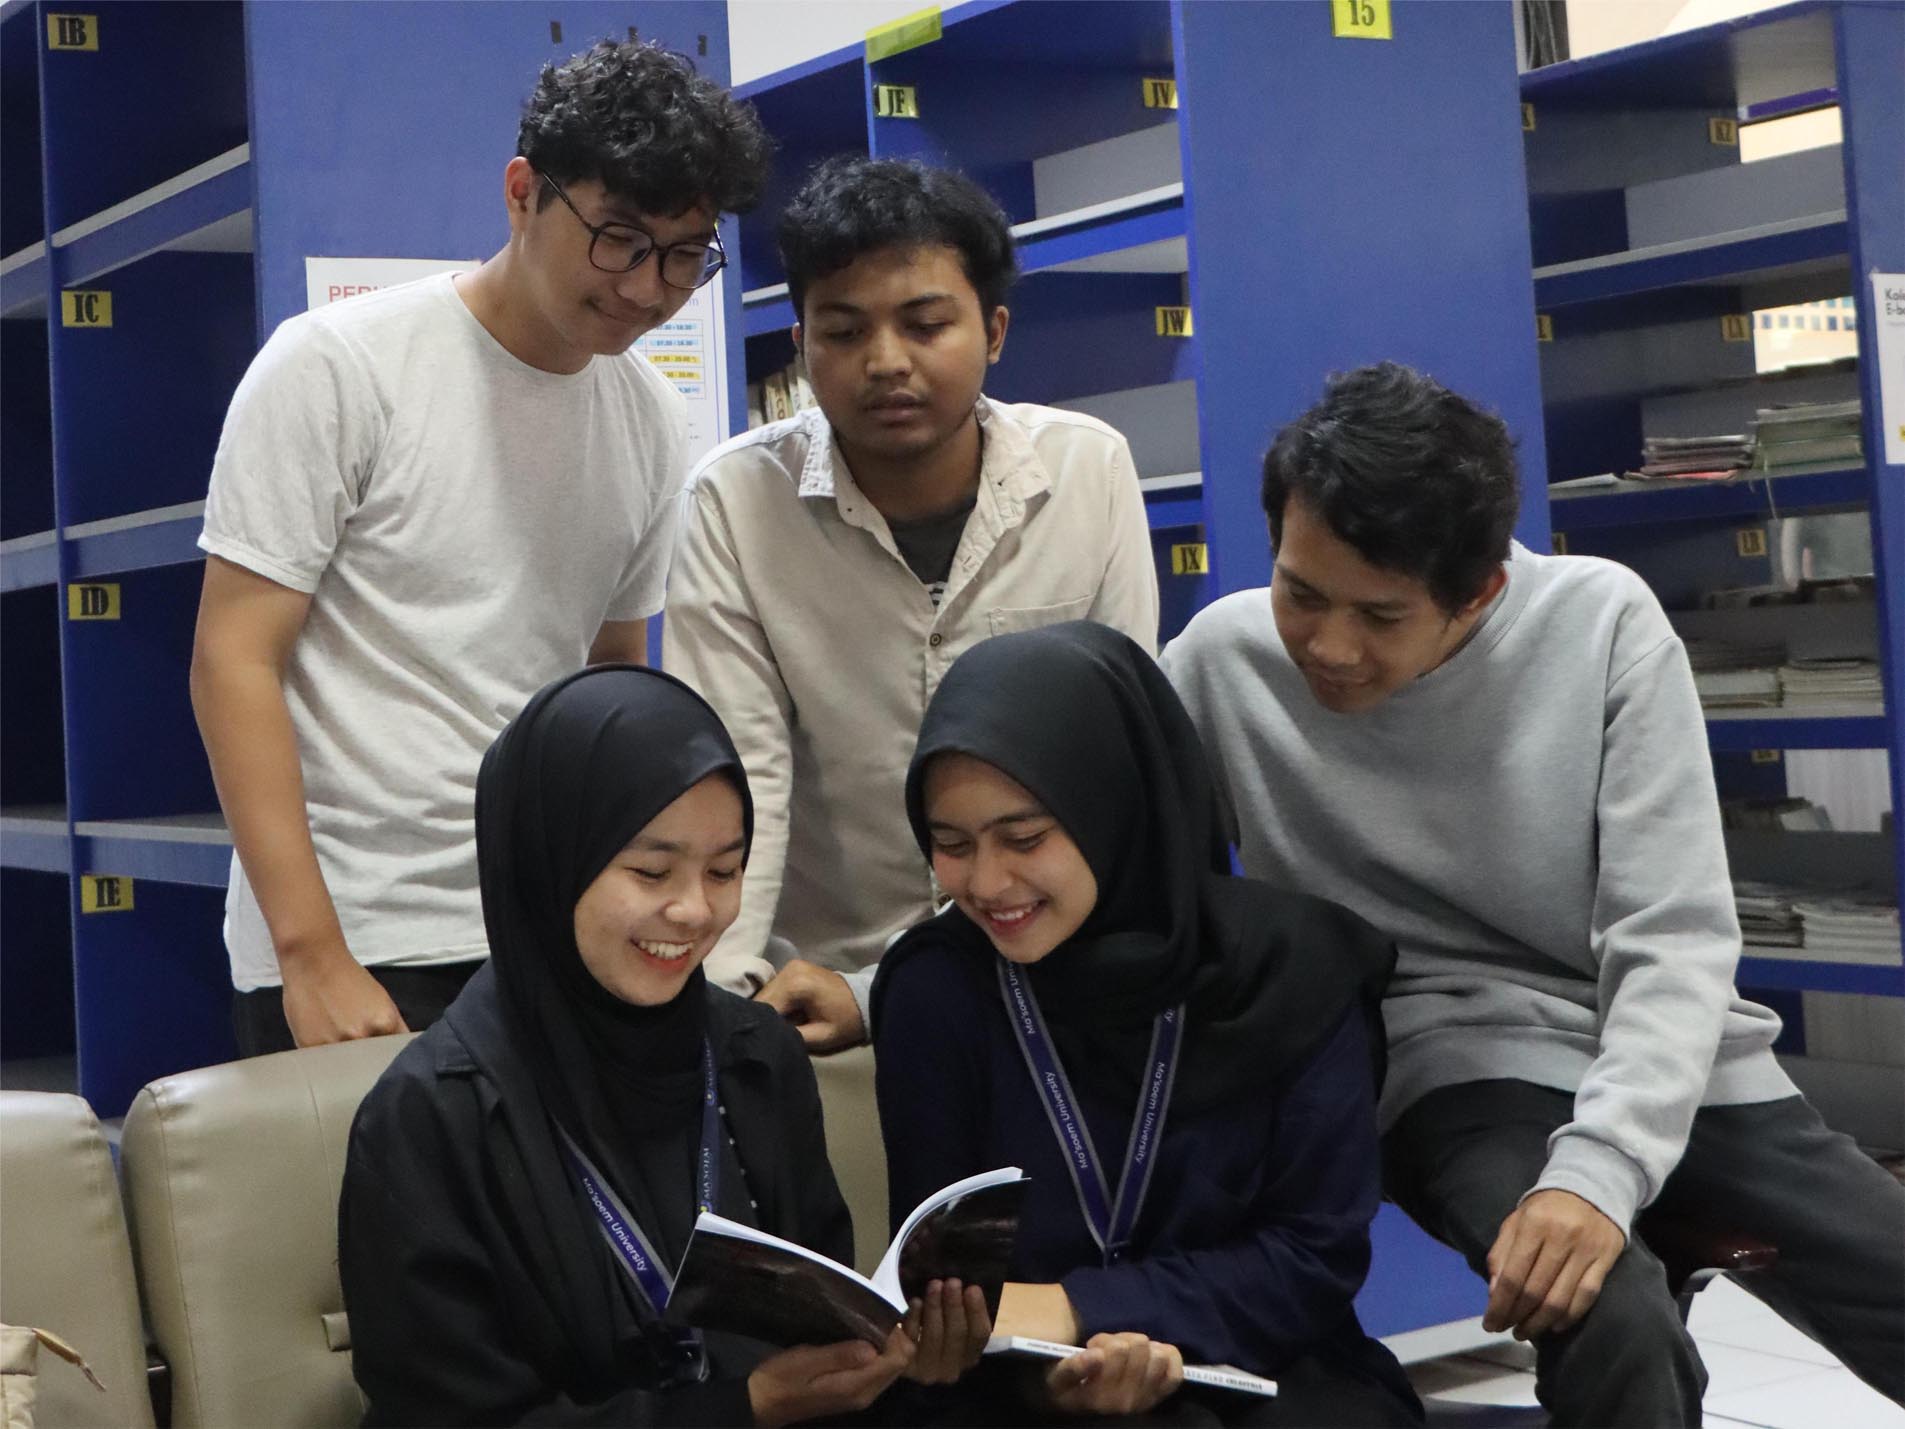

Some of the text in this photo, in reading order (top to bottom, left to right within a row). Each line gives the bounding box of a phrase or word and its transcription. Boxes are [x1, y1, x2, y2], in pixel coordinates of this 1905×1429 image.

[1348, 0, 1375, 26] 15
[56, 17, 87, 46] IB
[887, 88, 905, 116] JF
[74, 293, 99, 323] IC
[1162, 309, 1185, 336] JW
[1181, 547, 1200, 572] JX
[80, 586, 109, 616] ID
[94, 878, 121, 908] IE
[1045, 1071, 1088, 1169] Ma'soem University
[1135, 1112, 1155, 1164] University
[611, 1222, 648, 1271] University
